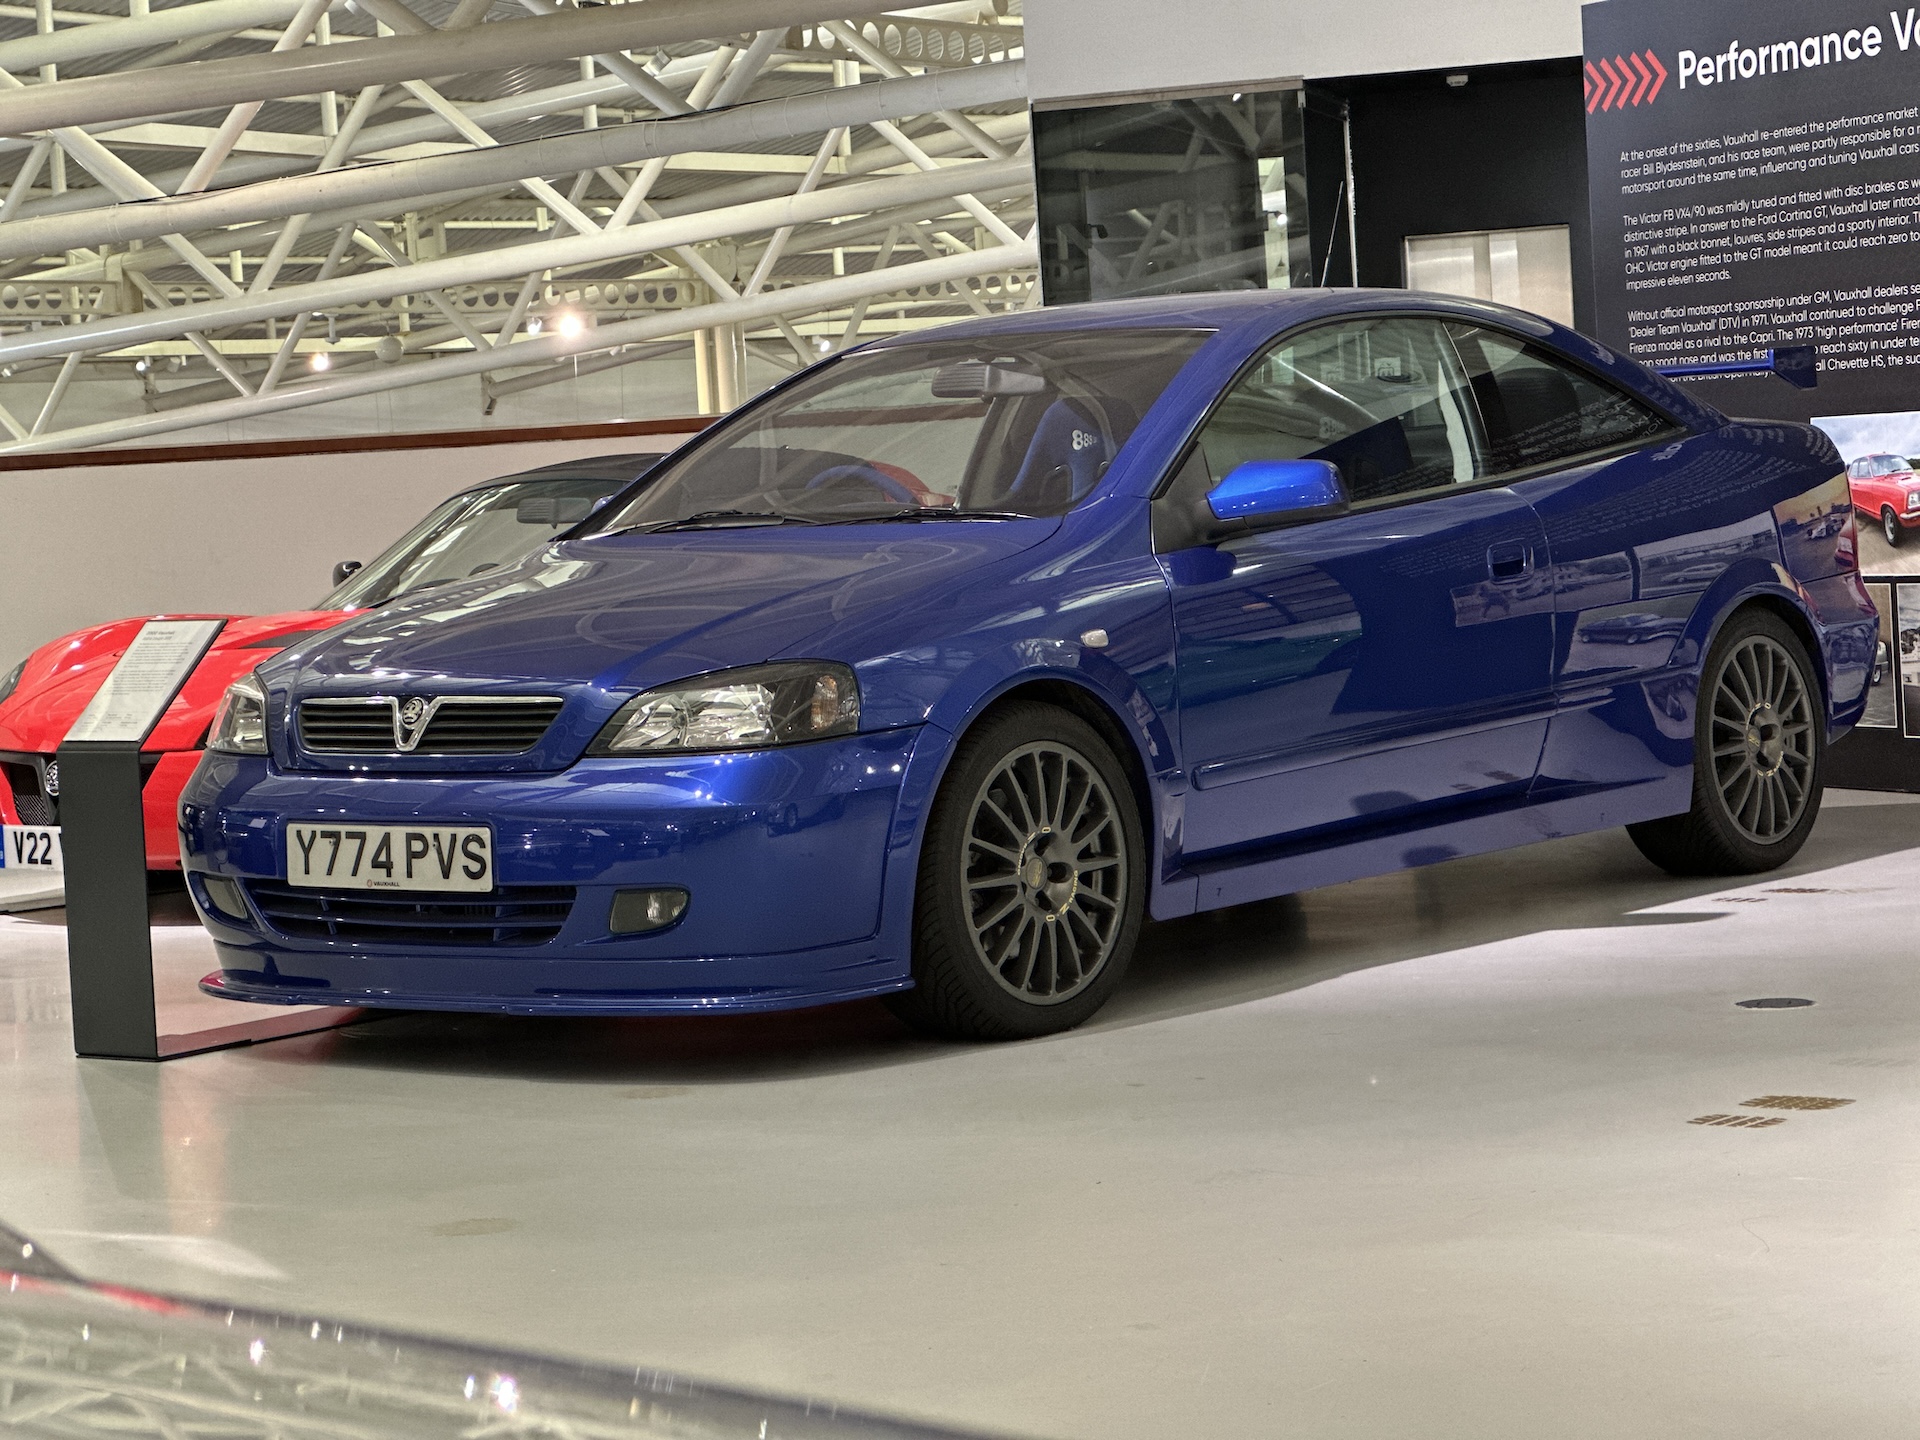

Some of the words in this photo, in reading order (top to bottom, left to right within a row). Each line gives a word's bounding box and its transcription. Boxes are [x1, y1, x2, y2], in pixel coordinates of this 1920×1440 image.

[1679, 26, 1882, 89] Performance
[1620, 151, 1629, 162] At
[1630, 149, 1644, 161] the
[1645, 145, 1668, 159] onset
[1669, 142, 1678, 155] of
[1679, 141, 1693, 153] the
[1694, 137, 1722, 151] sixties,
[1722, 130, 1759, 146] Vauxhall
[1760, 122, 1807, 140] re-entered
[1808, 121, 1824, 133] the
[1826, 113, 1884, 133] performance
[1885, 106, 1918, 121] market
[1620, 167, 1641, 178] racer
[1642, 163, 1654, 175] Bill
[1708, 152, 1726, 165] and
[1727, 151, 1739, 162] his
[1740, 149, 1760, 160] race
[1761, 145, 1787, 157] team,
[1788, 141, 1810, 153] were
[1811, 136, 1838, 152] partly
[1839, 128, 1891, 146] responsible
[1892, 126, 1905, 138] for
[1907, 126, 1915, 136] a
[1621, 179, 1665, 194] motorsport
[1666, 173, 1696, 188] around
[1697, 172, 1712, 184] the
[1712, 169, 1736, 181] same
[1737, 166, 1758, 178] time,
[1760, 159, 1806, 174] influencing
[1808, 154, 1826, 167] and
[1828, 152, 1857, 164] tuning
[1858, 144, 1897, 160] Vauxhall
[1899, 143, 1920, 155] cars
[1622, 215, 1638, 226] The
[1638, 213, 1662, 224] Victor
[1663, 209, 1674, 221] FB
[1674, 205, 1705, 219] VX4/90
[1706, 204, 1724, 215] was
[1725, 200, 1750, 213] mildly
[1751, 196, 1777, 209] tuned
[1778, 193, 1797, 206] and
[1798, 190, 1822, 203] fitted
[1823, 187, 1843, 199] with
[1844, 185, 1863, 197] disc
[1864, 181, 1896, 194] brakes
[1897, 180, 1909, 190] as
[1623, 228, 1663, 242] distinctive
[1664, 225, 1689, 238] stripe.
[1690, 223, 1698, 234] In
[1699, 220, 1729, 233] answer
[1730, 218, 1740, 229] to
[1741, 216, 1756, 227] the
[1757, 212, 1777, 225] Ford
[1778, 209, 1812, 222] Cortina
[1813, 206, 1828, 218] GT,
[1829, 201, 1868, 216] Vauxhall
[1869, 199, 1891, 211] later
[1624, 247, 1632, 258] in
[1632, 245, 1649, 257] 1967
[1650, 243, 1668, 255] with
[1668, 244, 1675, 253] a
[1676, 239, 1699, 252] black
[1700, 236, 1732, 249] bonnet,
[1734, 233, 1765, 245] louvres,
[1767, 229, 1785, 241] side
[1787, 226, 1816, 239] stripes
[1817, 222, 1836, 235] and
[1837, 223, 1845, 232] a
[1846, 218, 1876, 233] sporty
[1877, 214, 1911, 227] interior.
[1913, 212, 1920, 223] T
[1625, 262, 1645, 274] OHC
[1645, 260, 1669, 272] Victor
[1670, 257, 1698, 271] engine
[1699, 253, 1721, 265] fitted
[1722, 253, 1732, 263] to
[1733, 250, 1748, 262] the
[1749, 248, 1762, 260] GT
[1763, 244, 1791, 258] model
[1793, 241, 1822, 254] meant
[1824, 240, 1830, 251] it
[1831, 237, 1857, 250] could
[1859, 234, 1886, 247] reach
[1888, 232, 1908, 244] zero
[1909, 230, 1920, 241] to
[1626, 276, 1666, 291] impressive
[1667, 274, 1694, 286] eleven
[1695, 268, 1731, 283] seconds.
[1627, 310, 1659, 322] Without
[1659, 305, 1686, 319] official
[1687, 301, 1733, 316] motorsport
[1734, 296, 1785, 313] sponsorship
[1786, 293, 1812, 306] under
[1813, 290, 1832, 304] GM,
[1833, 286, 1872, 301] Vauxhall
[1873, 284, 1909, 298] dealers
[1657, 323, 1680, 335] Team
[1718, 316, 1740, 330] (DTV)
[1741, 316, 1750, 327] in
[1770, 310, 1807, 324] Vauxhall
[1809, 305, 1854, 321] continued
[1855, 306, 1866, 316] to
[1867, 302, 1914, 315] challenge
[1629, 342, 1657, 353] Firenza
[1658, 338, 1683, 351] model
[1684, 339, 1695, 349] as
[1696, 339, 1702, 348] a
[1704, 334, 1721, 347] rival
[1722, 335, 1732, 346] to
[1733, 333, 1748, 344] the
[1749, 330, 1775, 344] Capri.
[1776, 329, 1793, 340] The
[1794, 326, 1814, 339] 1973
[1699, 351, 1717, 362] and
[1718, 352, 1736, 362] was
[1736, 349, 1752, 361] the
[1753, 347, 1768, 359] first
[1820, 340, 1846, 354] reach
[1847, 339, 1869, 353] sixty
[1870, 338, 1879, 349] in
[1880, 336, 1908, 349] under
[1827, 357, 1869, 370] Chevette
[1870, 354, 1886, 368] HS,
[1887, 354, 1903, 366] the
[13, 831, 52, 865] V22
[296, 829, 394, 878] Y774
[405, 832, 487, 880] PVS
